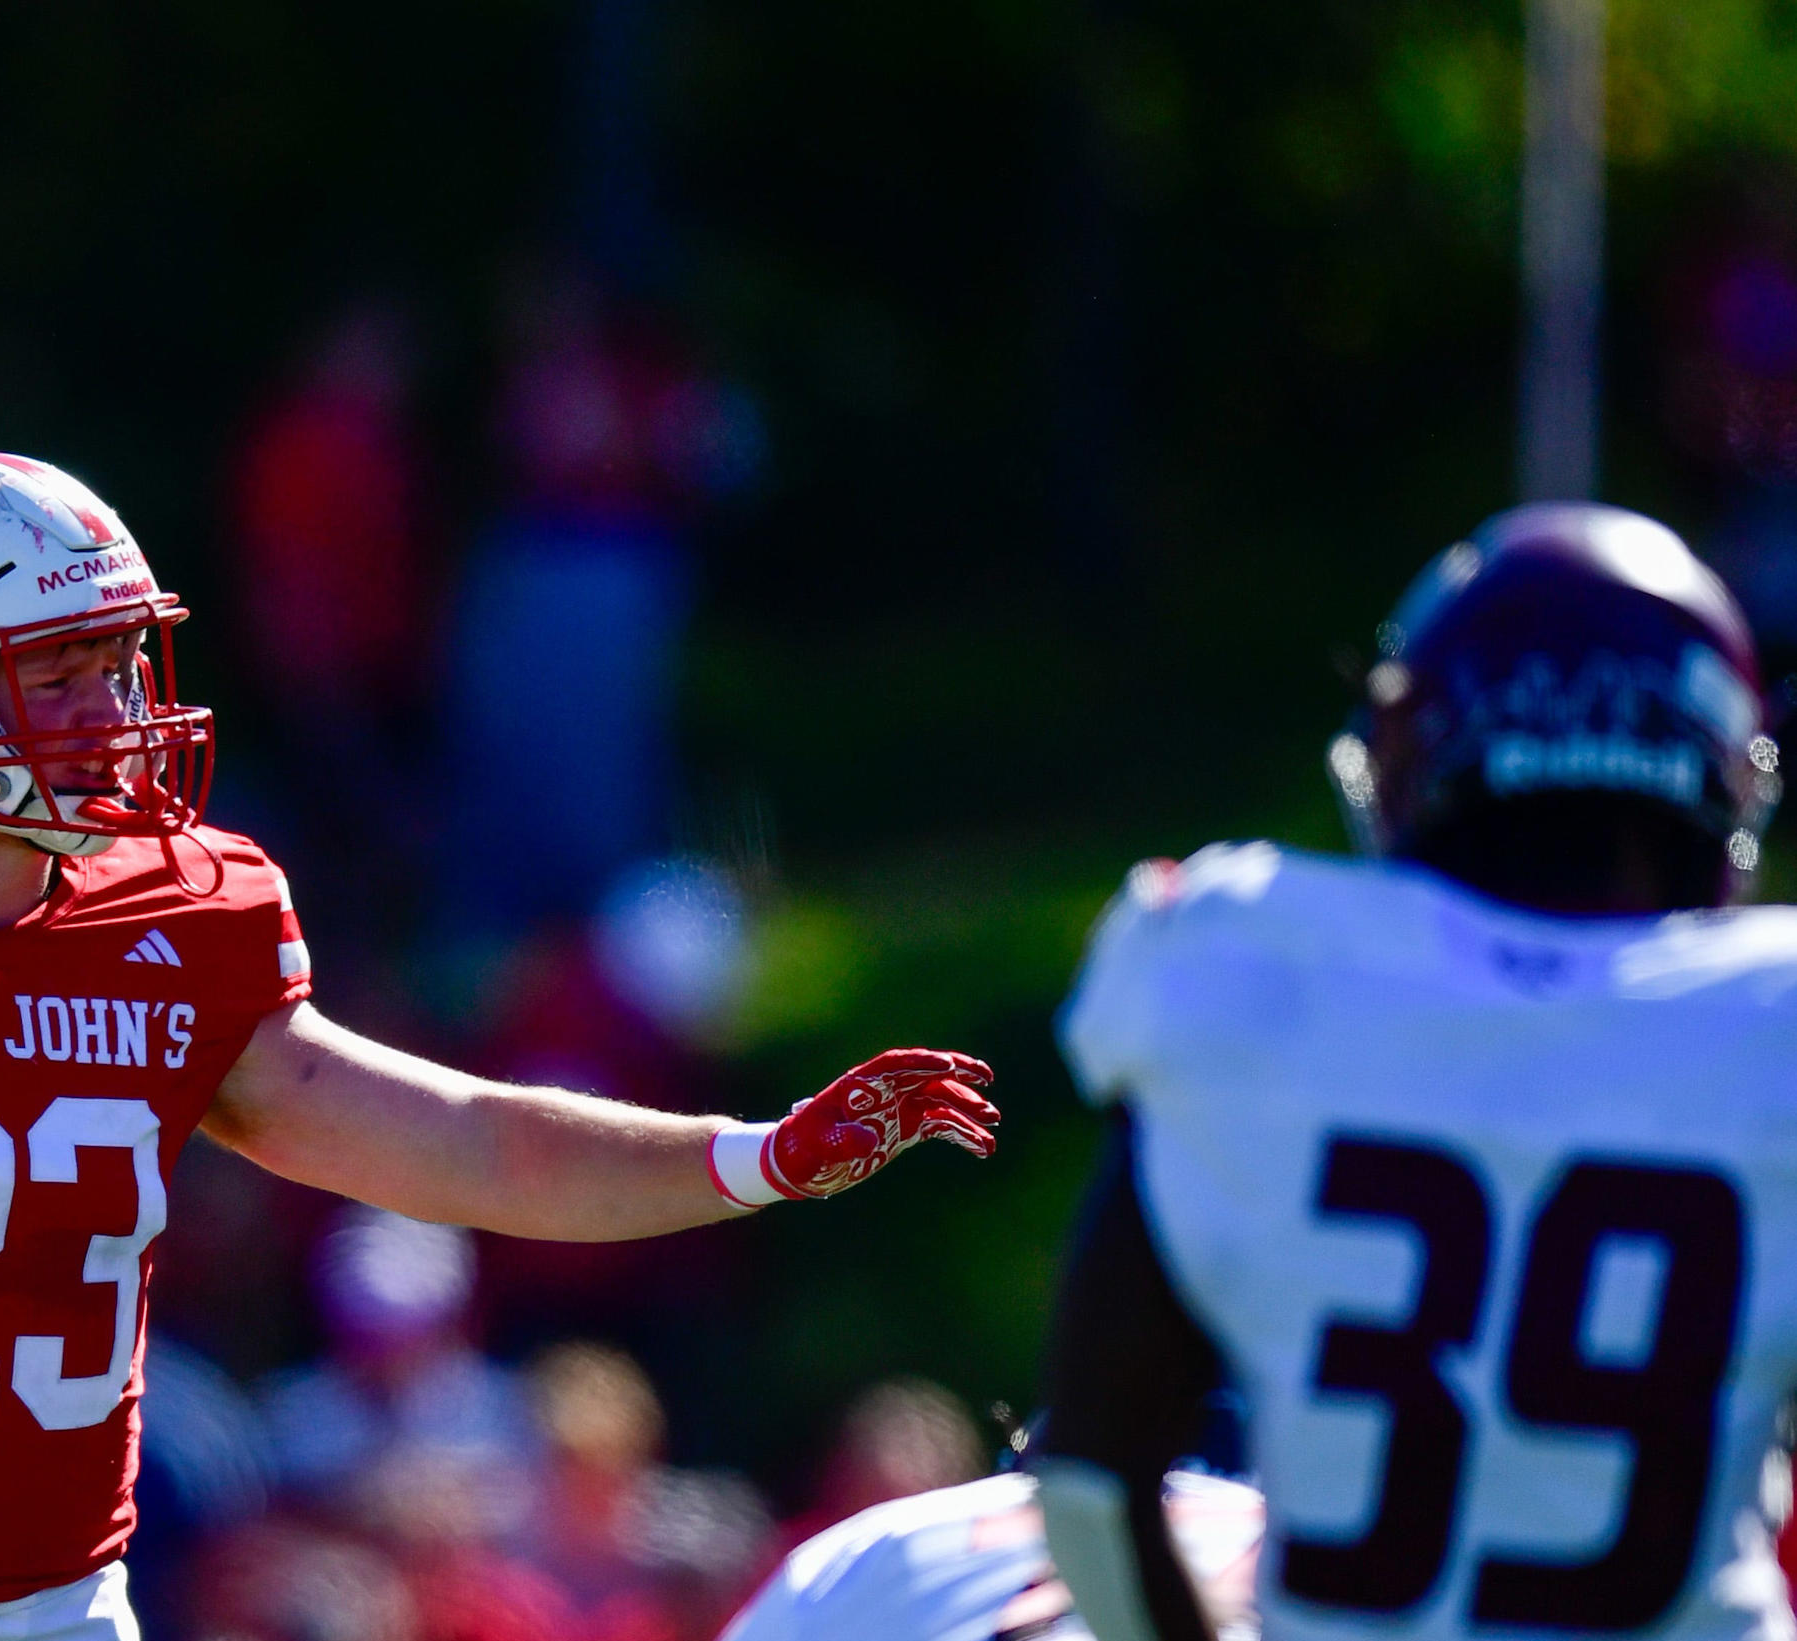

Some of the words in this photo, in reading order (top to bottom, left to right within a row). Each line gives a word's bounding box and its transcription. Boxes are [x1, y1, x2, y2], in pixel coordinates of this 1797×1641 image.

[36, 551, 146, 594] MCMAHO
[4, 994, 197, 1069] JOHN'S
[1279, 1130, 1749, 1637] 39
